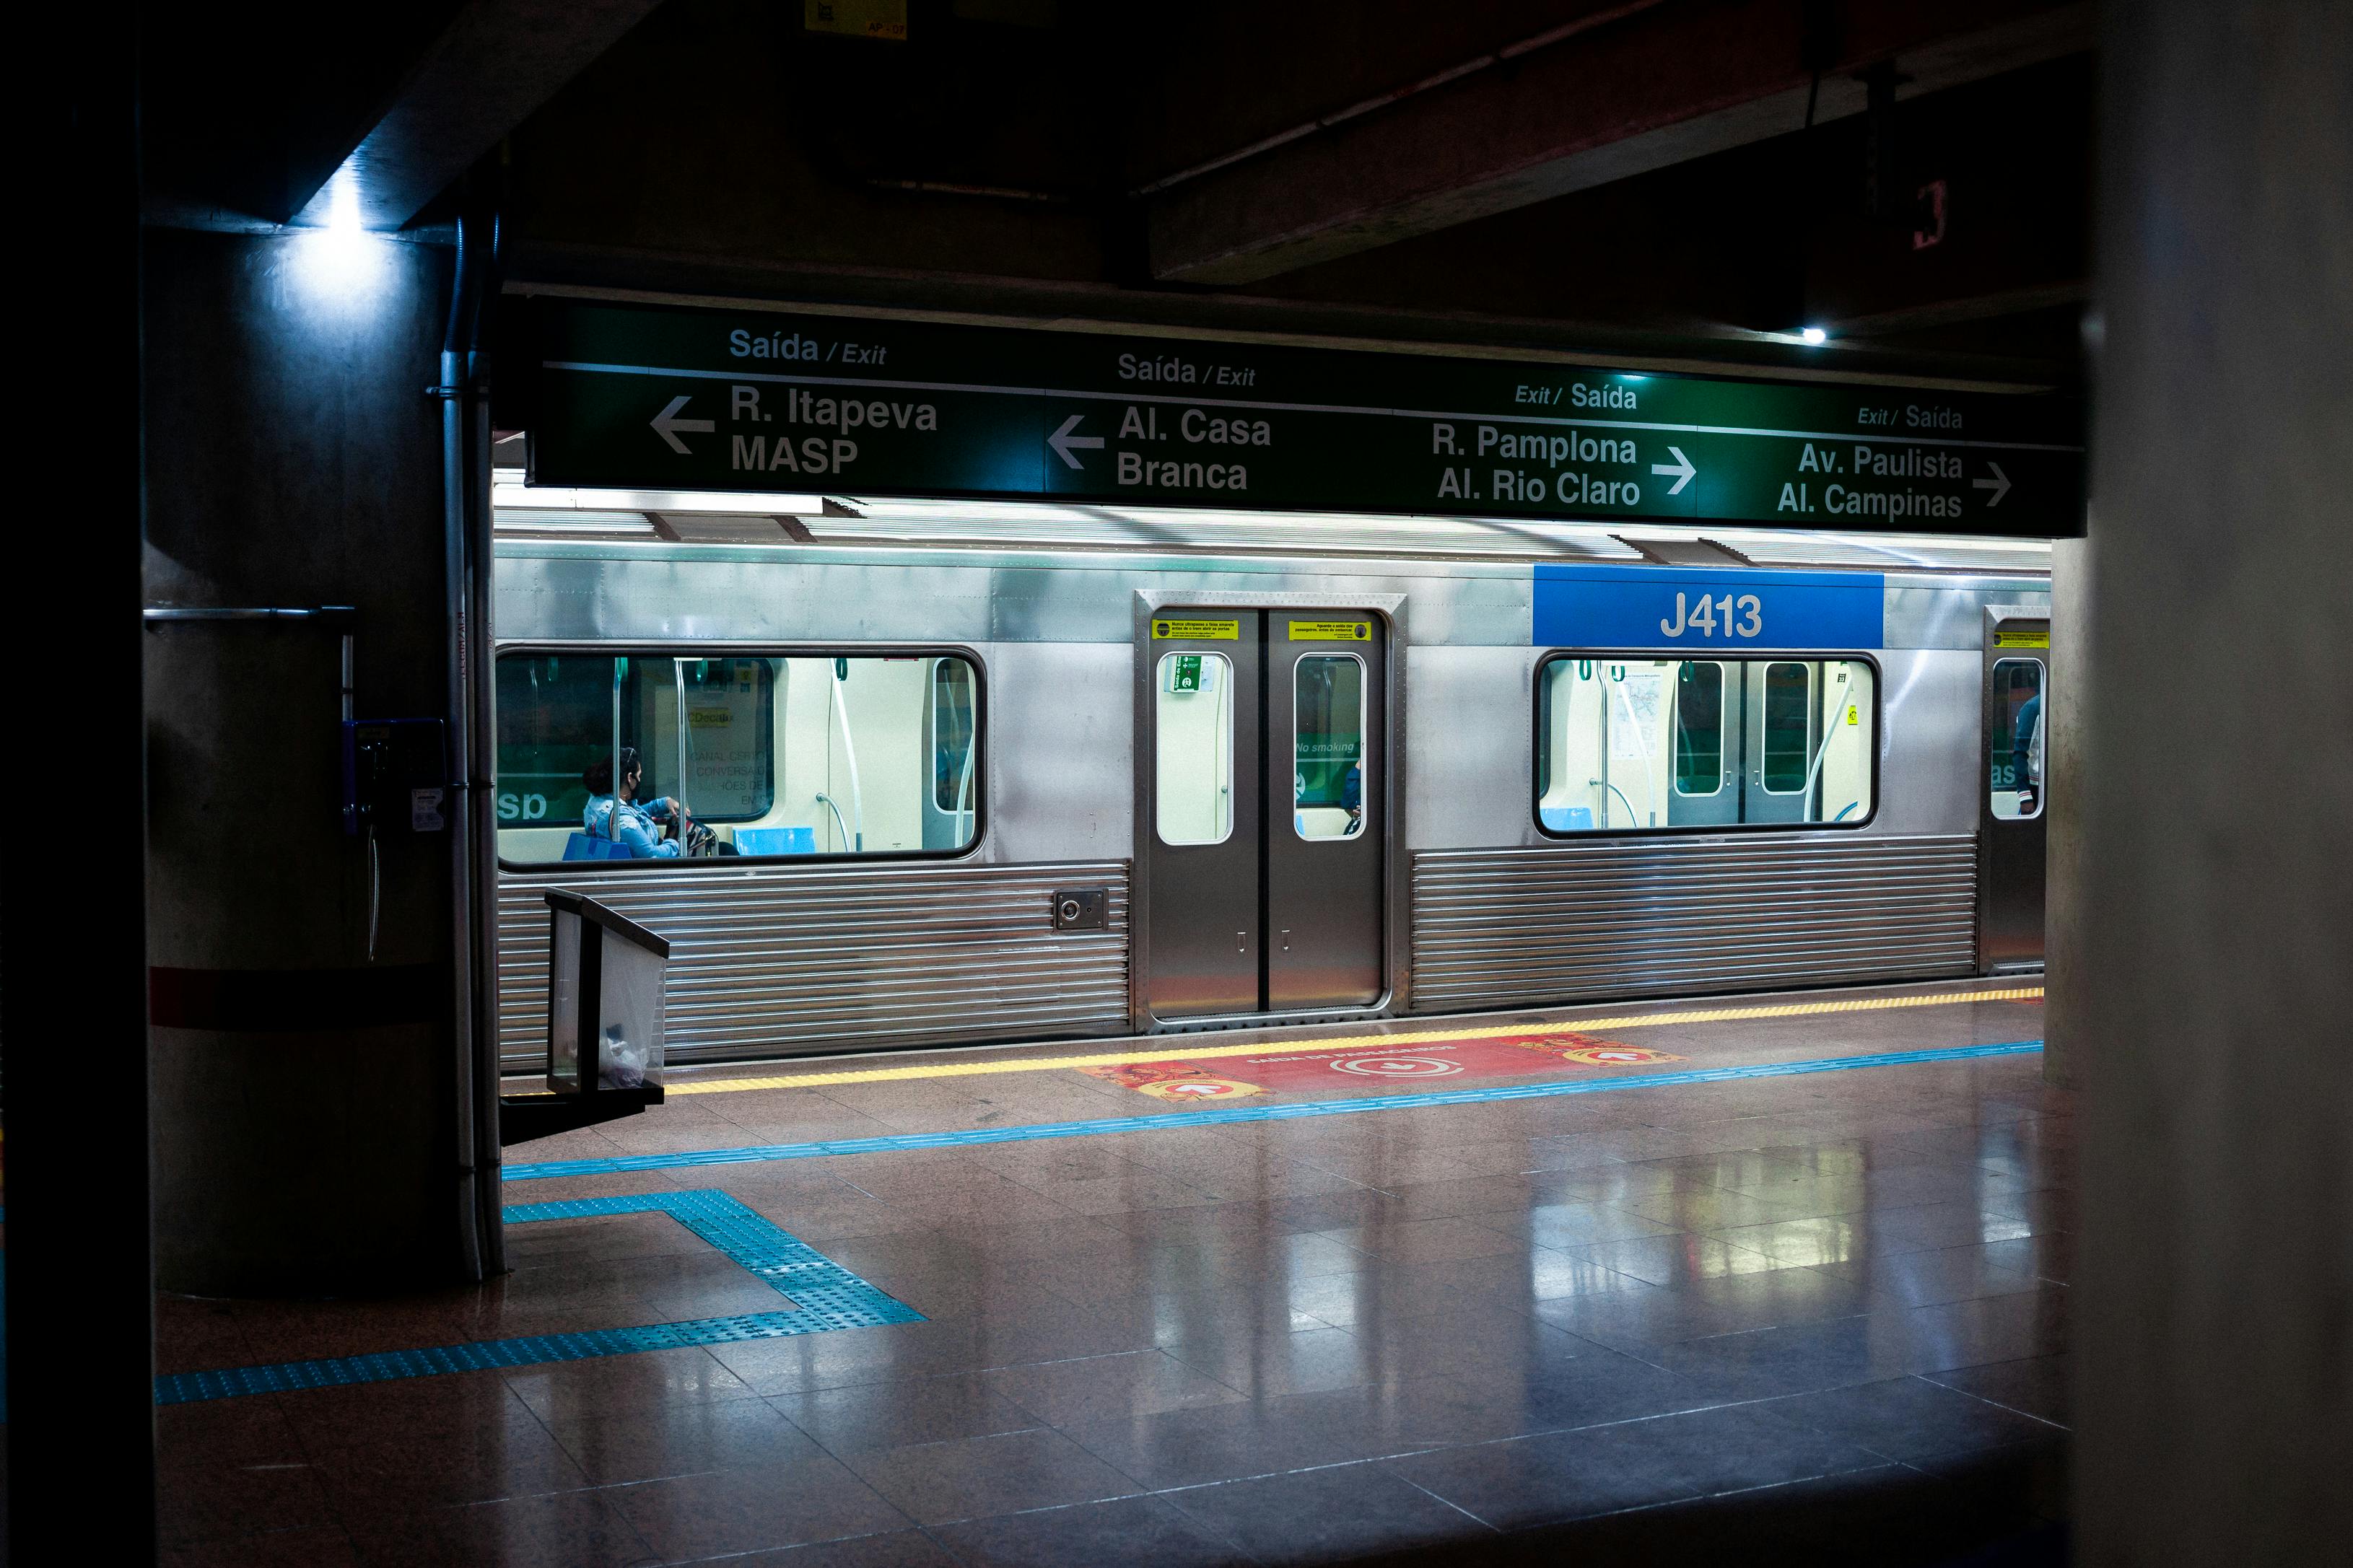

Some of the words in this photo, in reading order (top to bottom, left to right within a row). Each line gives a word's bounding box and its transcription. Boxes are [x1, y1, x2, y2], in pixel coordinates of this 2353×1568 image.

[730, 329, 818, 361] Saída
[842, 343, 887, 365] Exit
[1118, 353, 1196, 383] Saída
[1216, 366, 1256, 387] Exit
[731, 385, 772, 421] R.
[789, 387, 940, 435] Itapeva
[1515, 385, 1551, 404] Exit
[1572, 382, 1639, 410] Saída
[1118, 406, 1167, 441] Al.
[1181, 408, 1271, 446] Casa
[1857, 407, 1888, 425] Exit
[1906, 404, 1963, 429] Saída
[732, 434, 858, 474] MASP
[1433, 423, 1464, 455] R.
[1478, 424, 1637, 468] Pamplona
[1798, 443, 1843, 473] Av.
[1854, 445, 1962, 478] Paulista
[1117, 452, 1247, 490] Branca
[1437, 467, 1480, 499] Al.
[1493, 469, 1546, 502] Rio
[1557, 472, 1641, 506] Claro
[1777, 482, 1815, 512] Al.
[1825, 483, 1961, 523] Campinas
[1660, 592, 1762, 638] J413
[1296, 743, 1309, 752] No
[1311, 742, 1354, 753] smoking
